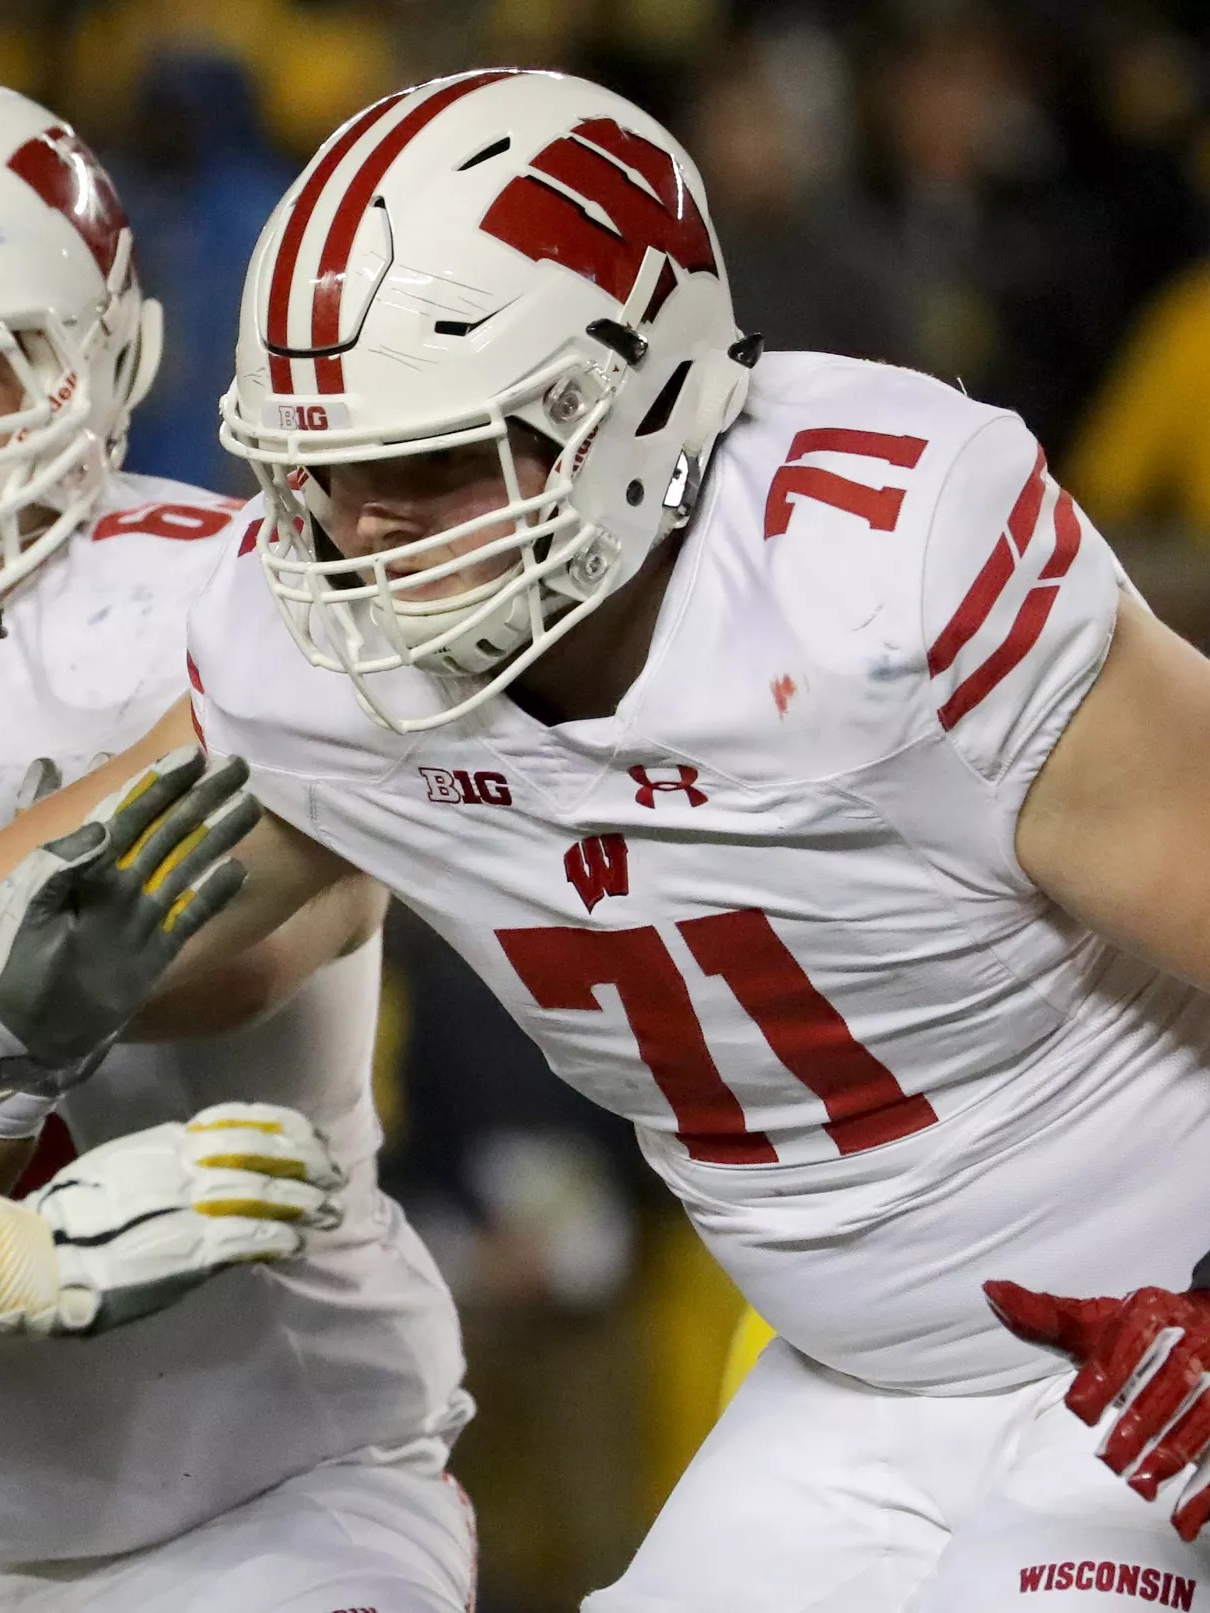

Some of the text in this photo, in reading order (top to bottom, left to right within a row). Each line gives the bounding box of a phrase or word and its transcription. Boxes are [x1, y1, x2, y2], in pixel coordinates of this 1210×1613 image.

[764, 427, 929, 541] 71
[563, 832, 629, 915] W
[493, 907, 939, 1165] 71
[1019, 1560, 1196, 1612] WISCONSIN
